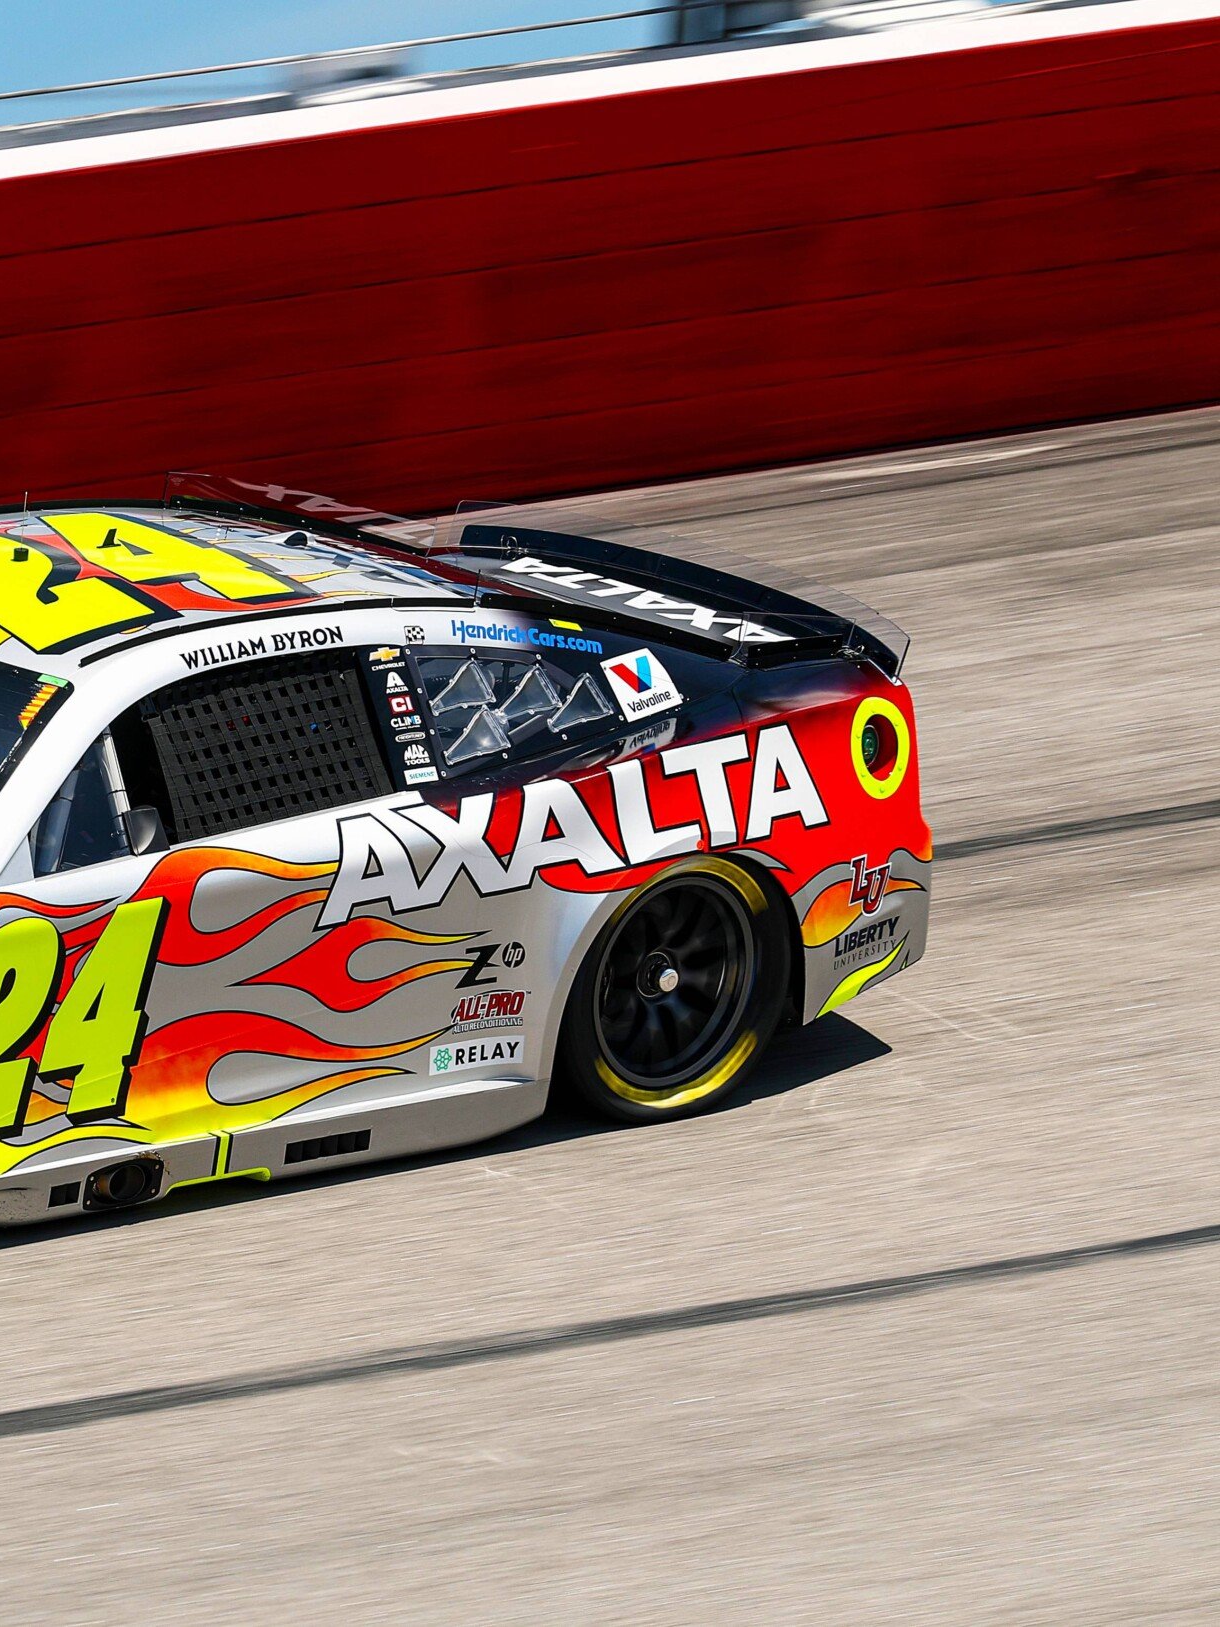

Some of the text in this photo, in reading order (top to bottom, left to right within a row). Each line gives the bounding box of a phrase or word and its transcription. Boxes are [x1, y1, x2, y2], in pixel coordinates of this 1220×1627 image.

[501, 557, 797, 642] AXALTA
[179, 626, 344, 669] WILLIAM BYRON
[390, 695, 415, 713] CI
[627, 691, 672, 713] Valvoline
[390, 714, 422, 728] CLIMB
[404, 743, 430, 760] MAC
[404, 757, 431, 766] TOOLS
[409, 771, 435, 780] SIEMENS
[315, 723, 829, 931] AXALTA
[848, 854, 892, 917] LU
[834, 915, 900, 958] LIBERTY
[833, 938, 899, 971] UNIVERSITY
[451, 990, 526, 1024] ALL-PRO
[454, 1041, 520, 1067] RELAY
